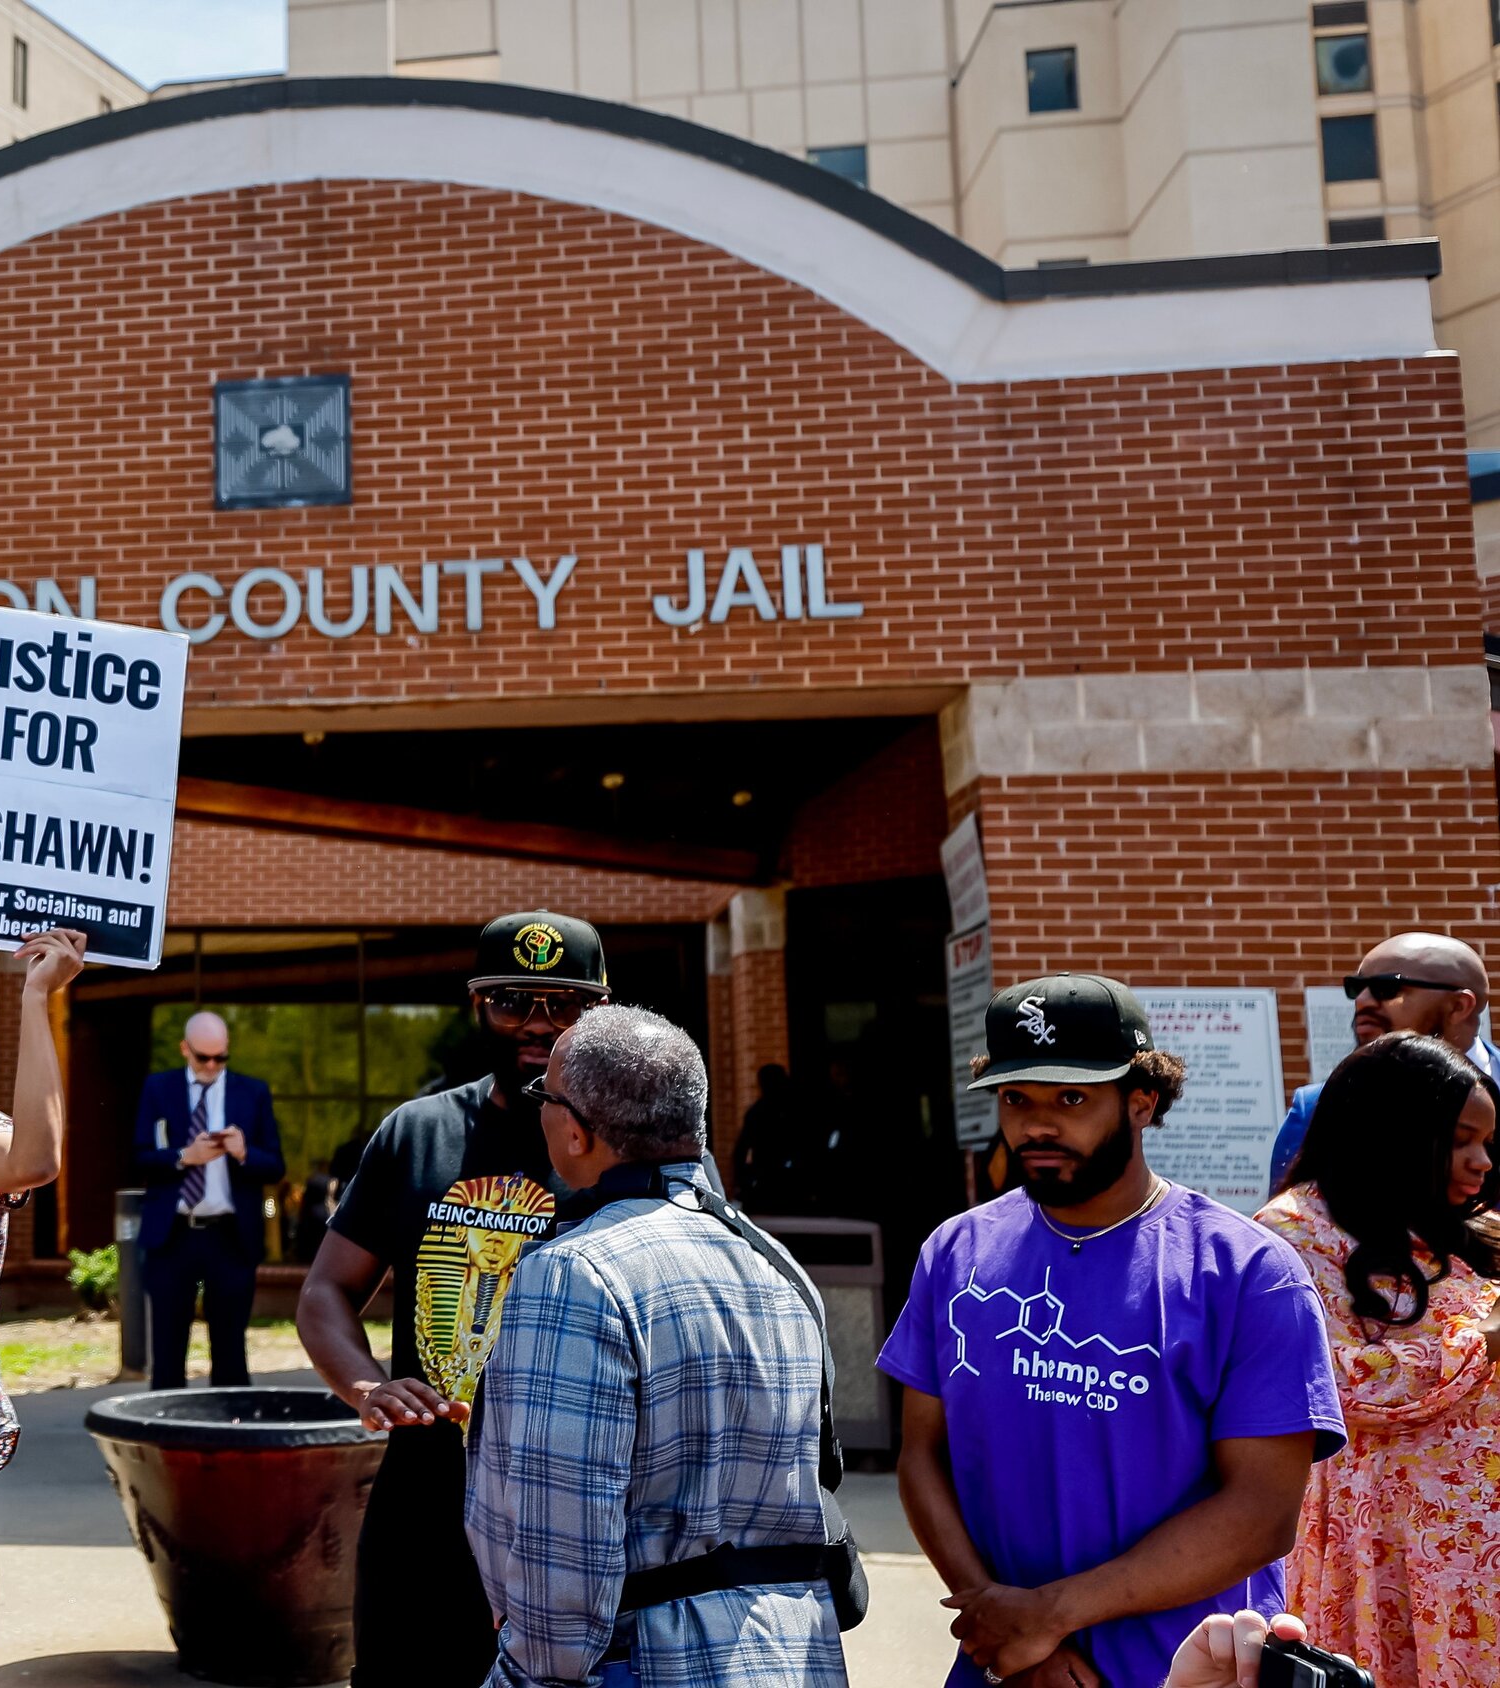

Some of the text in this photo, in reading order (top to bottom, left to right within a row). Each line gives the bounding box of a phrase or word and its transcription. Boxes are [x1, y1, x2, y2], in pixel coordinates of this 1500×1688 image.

[159, 555, 579, 645] COUNTY
[652, 543, 864, 627] JAIL
[0, 706, 98, 773] FOR
[13, 889, 102, 922] Socialism
[108, 907, 141, 929] and
[427, 1202, 551, 1235] REINCARNATION
[1086, 1391, 1119, 1412] CBD
